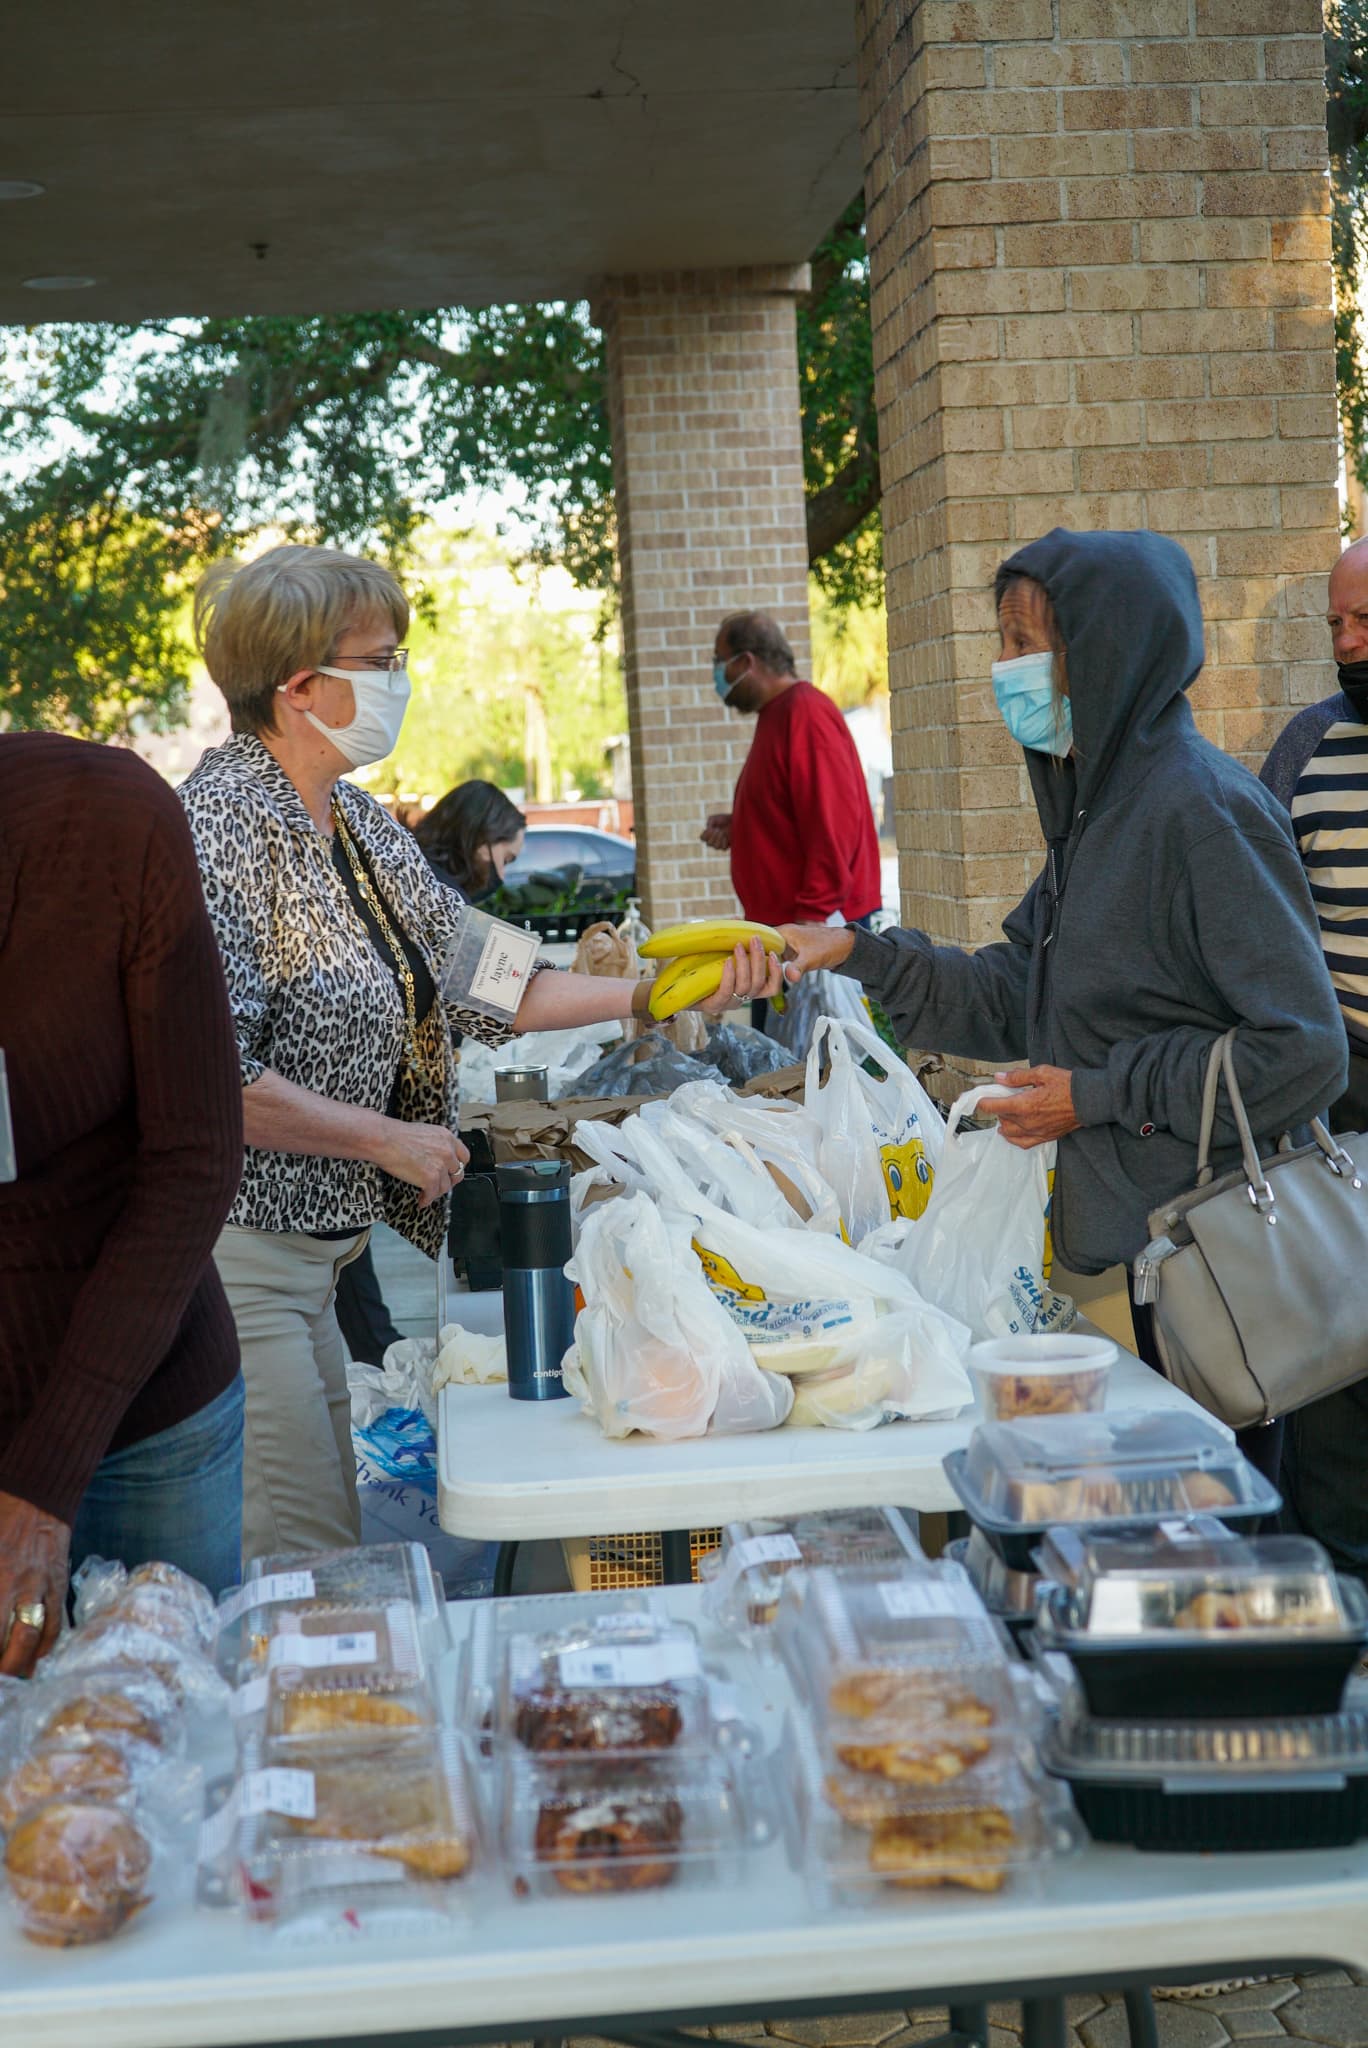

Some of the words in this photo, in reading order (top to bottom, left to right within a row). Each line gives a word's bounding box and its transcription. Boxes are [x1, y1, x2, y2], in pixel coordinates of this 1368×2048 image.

[490, 952, 508, 984] Jayne
[533, 1369, 564, 1378] contigo
[355, 1455, 409, 1507] hank
[419, 1498, 440, 1527] Yo
